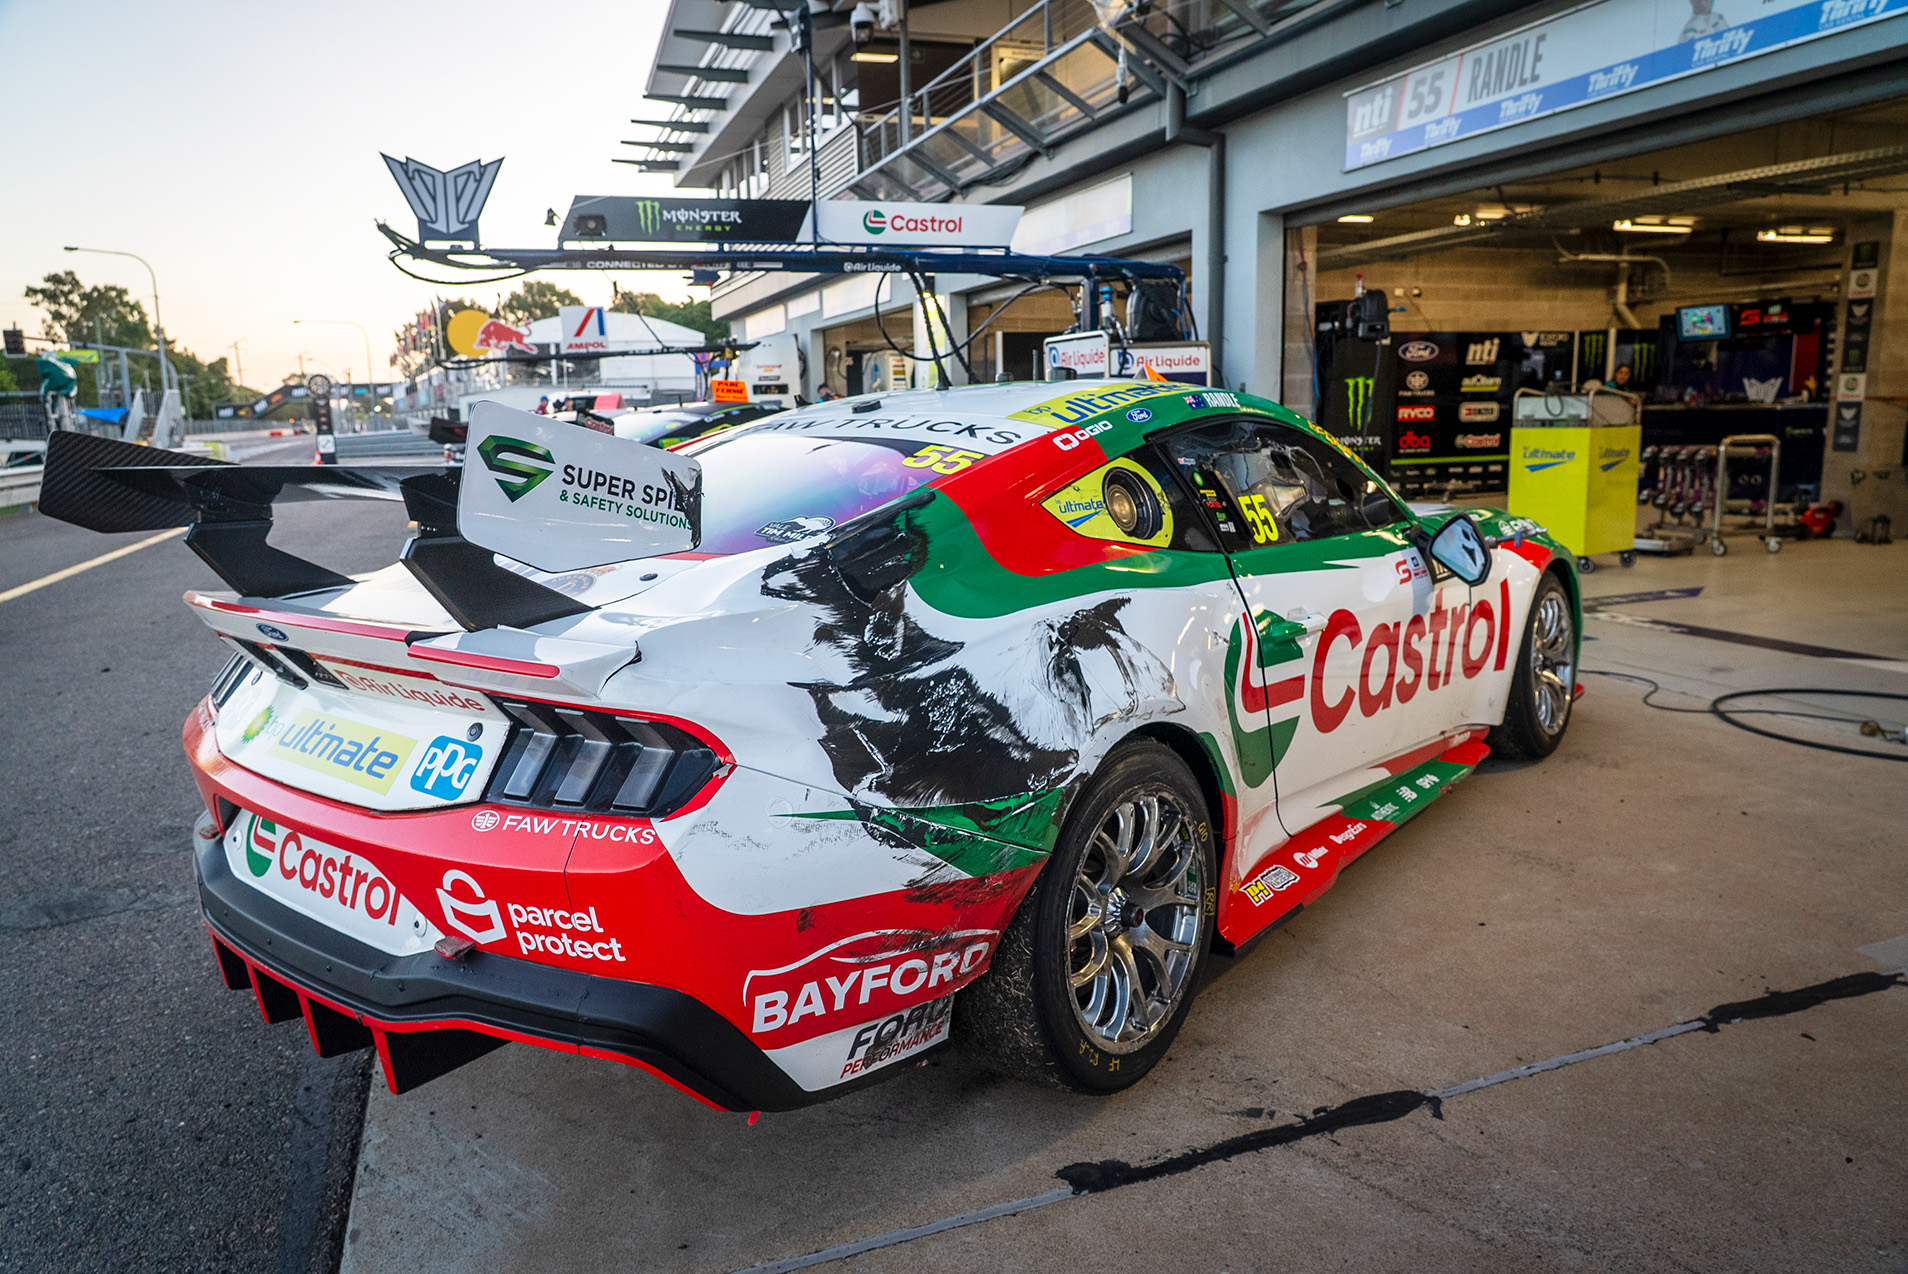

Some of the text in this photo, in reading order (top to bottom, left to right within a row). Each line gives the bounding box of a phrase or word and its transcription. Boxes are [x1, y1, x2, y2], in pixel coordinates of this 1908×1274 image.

[1408, 70, 1444, 119] 55
[1468, 34, 1548, 102] RANDLE
[662, 208, 742, 224] MONSTER
[890, 214, 963, 234] Castrol
[868, 262, 902, 274] Liquide
[567, 341, 607, 349] AMPOL
[1074, 350, 1105, 366] Liquide
[1466, 337, 1500, 361] nti
[1157, 354, 1200, 369] Liquide
[1023, 404, 1052, 415] bp
[1203, 393, 1240, 408] RANDLE
[834, 416, 1022, 445] TRUCKS
[1399, 431, 1430, 448] dba
[902, 444, 985, 475] 55
[561, 464, 636, 500] SUPER
[559, 489, 569, 502] &
[572, 491, 623, 515] SAFETY
[1058, 499, 1104, 515] ultimate
[761, 527, 784, 537] TIM
[1237, 494, 1279, 544] 55
[1310, 578, 1511, 733] Castrol
[365, 676, 486, 711] Air Liquide
[267, 715, 399, 779] bp ultimate
[415, 742, 478, 790] PPG
[502, 814, 656, 846] FAW TRUCKS
[278, 833, 398, 925] Castrol
[1188, 881, 1197, 895] 55
[507, 902, 604, 933] parcel
[516, 930, 627, 962] protect
[751, 942, 990, 1034] BAYFORD
[840, 1021, 945, 1079] PERFORMANCE
